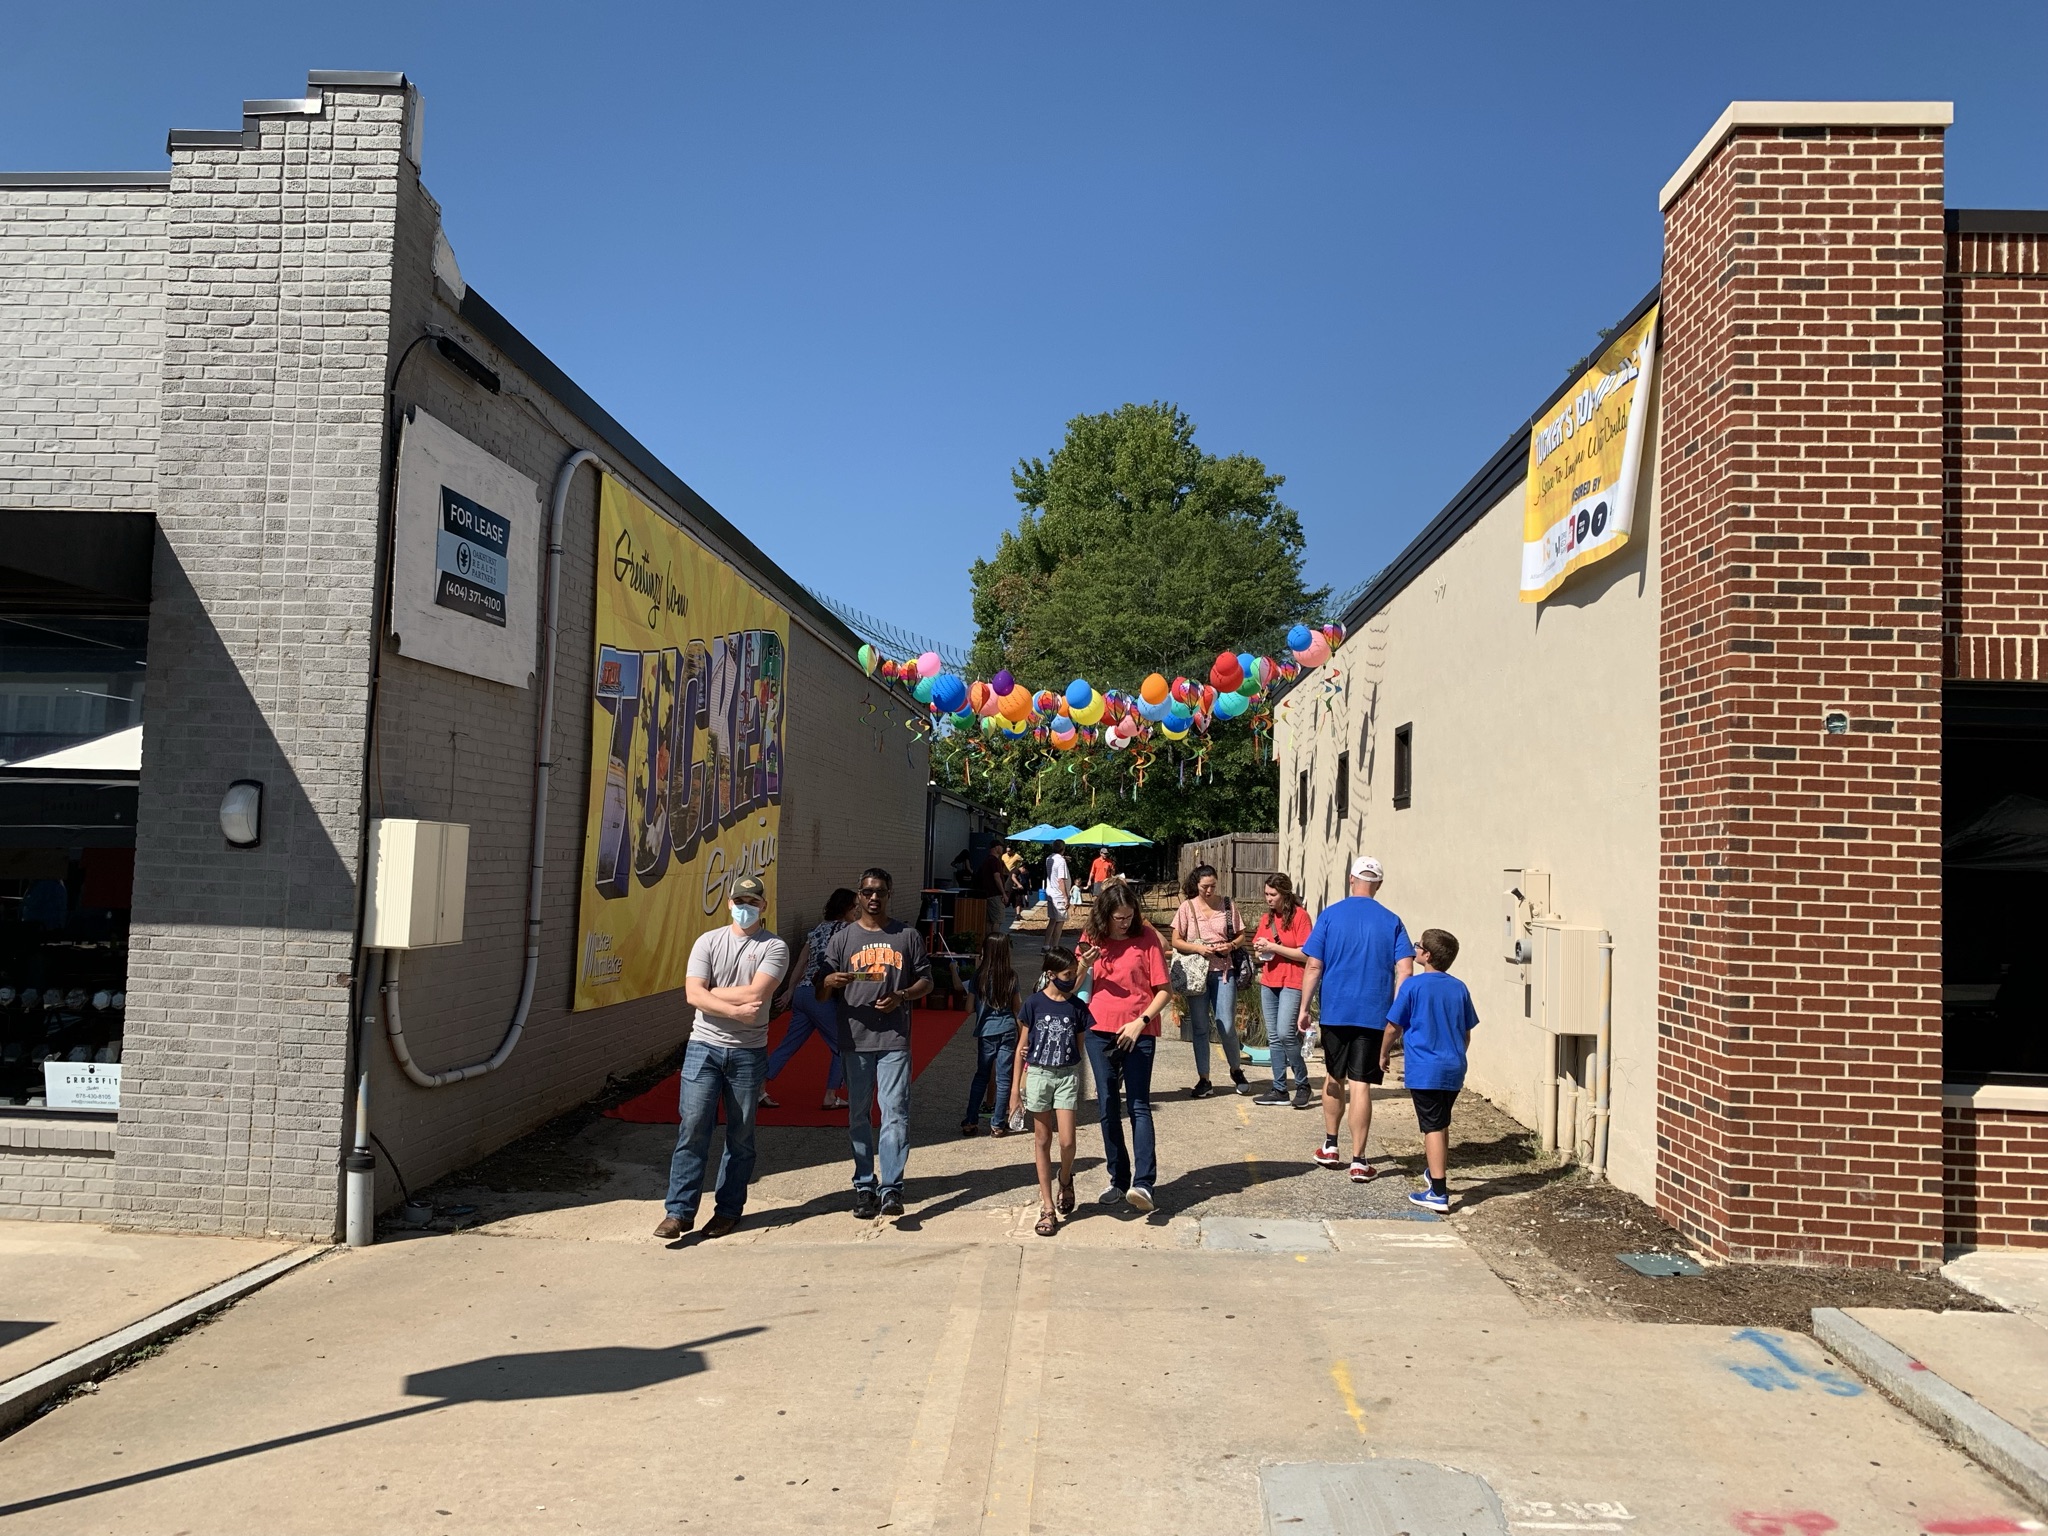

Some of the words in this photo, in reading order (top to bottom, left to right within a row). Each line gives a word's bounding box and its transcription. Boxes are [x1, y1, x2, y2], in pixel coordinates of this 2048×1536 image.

[1592, 475, 1602, 492] BY
[451, 503, 472, 530] FOR
[474, 515, 504, 545] LEASE
[471, 559, 497, 577] REALTY
[471, 568, 497, 586] PARTNERS
[614, 528, 663, 630] Greetings
[446, 580, 468, 601] (404)
[468, 589, 501, 612] 371-4100
[596, 628, 784, 896] TUCKER
[862, 942, 891, 950] CLEMSON
[850, 947, 903, 972] TIGERS
[66, 1076, 118, 1086] CROSSFIT
